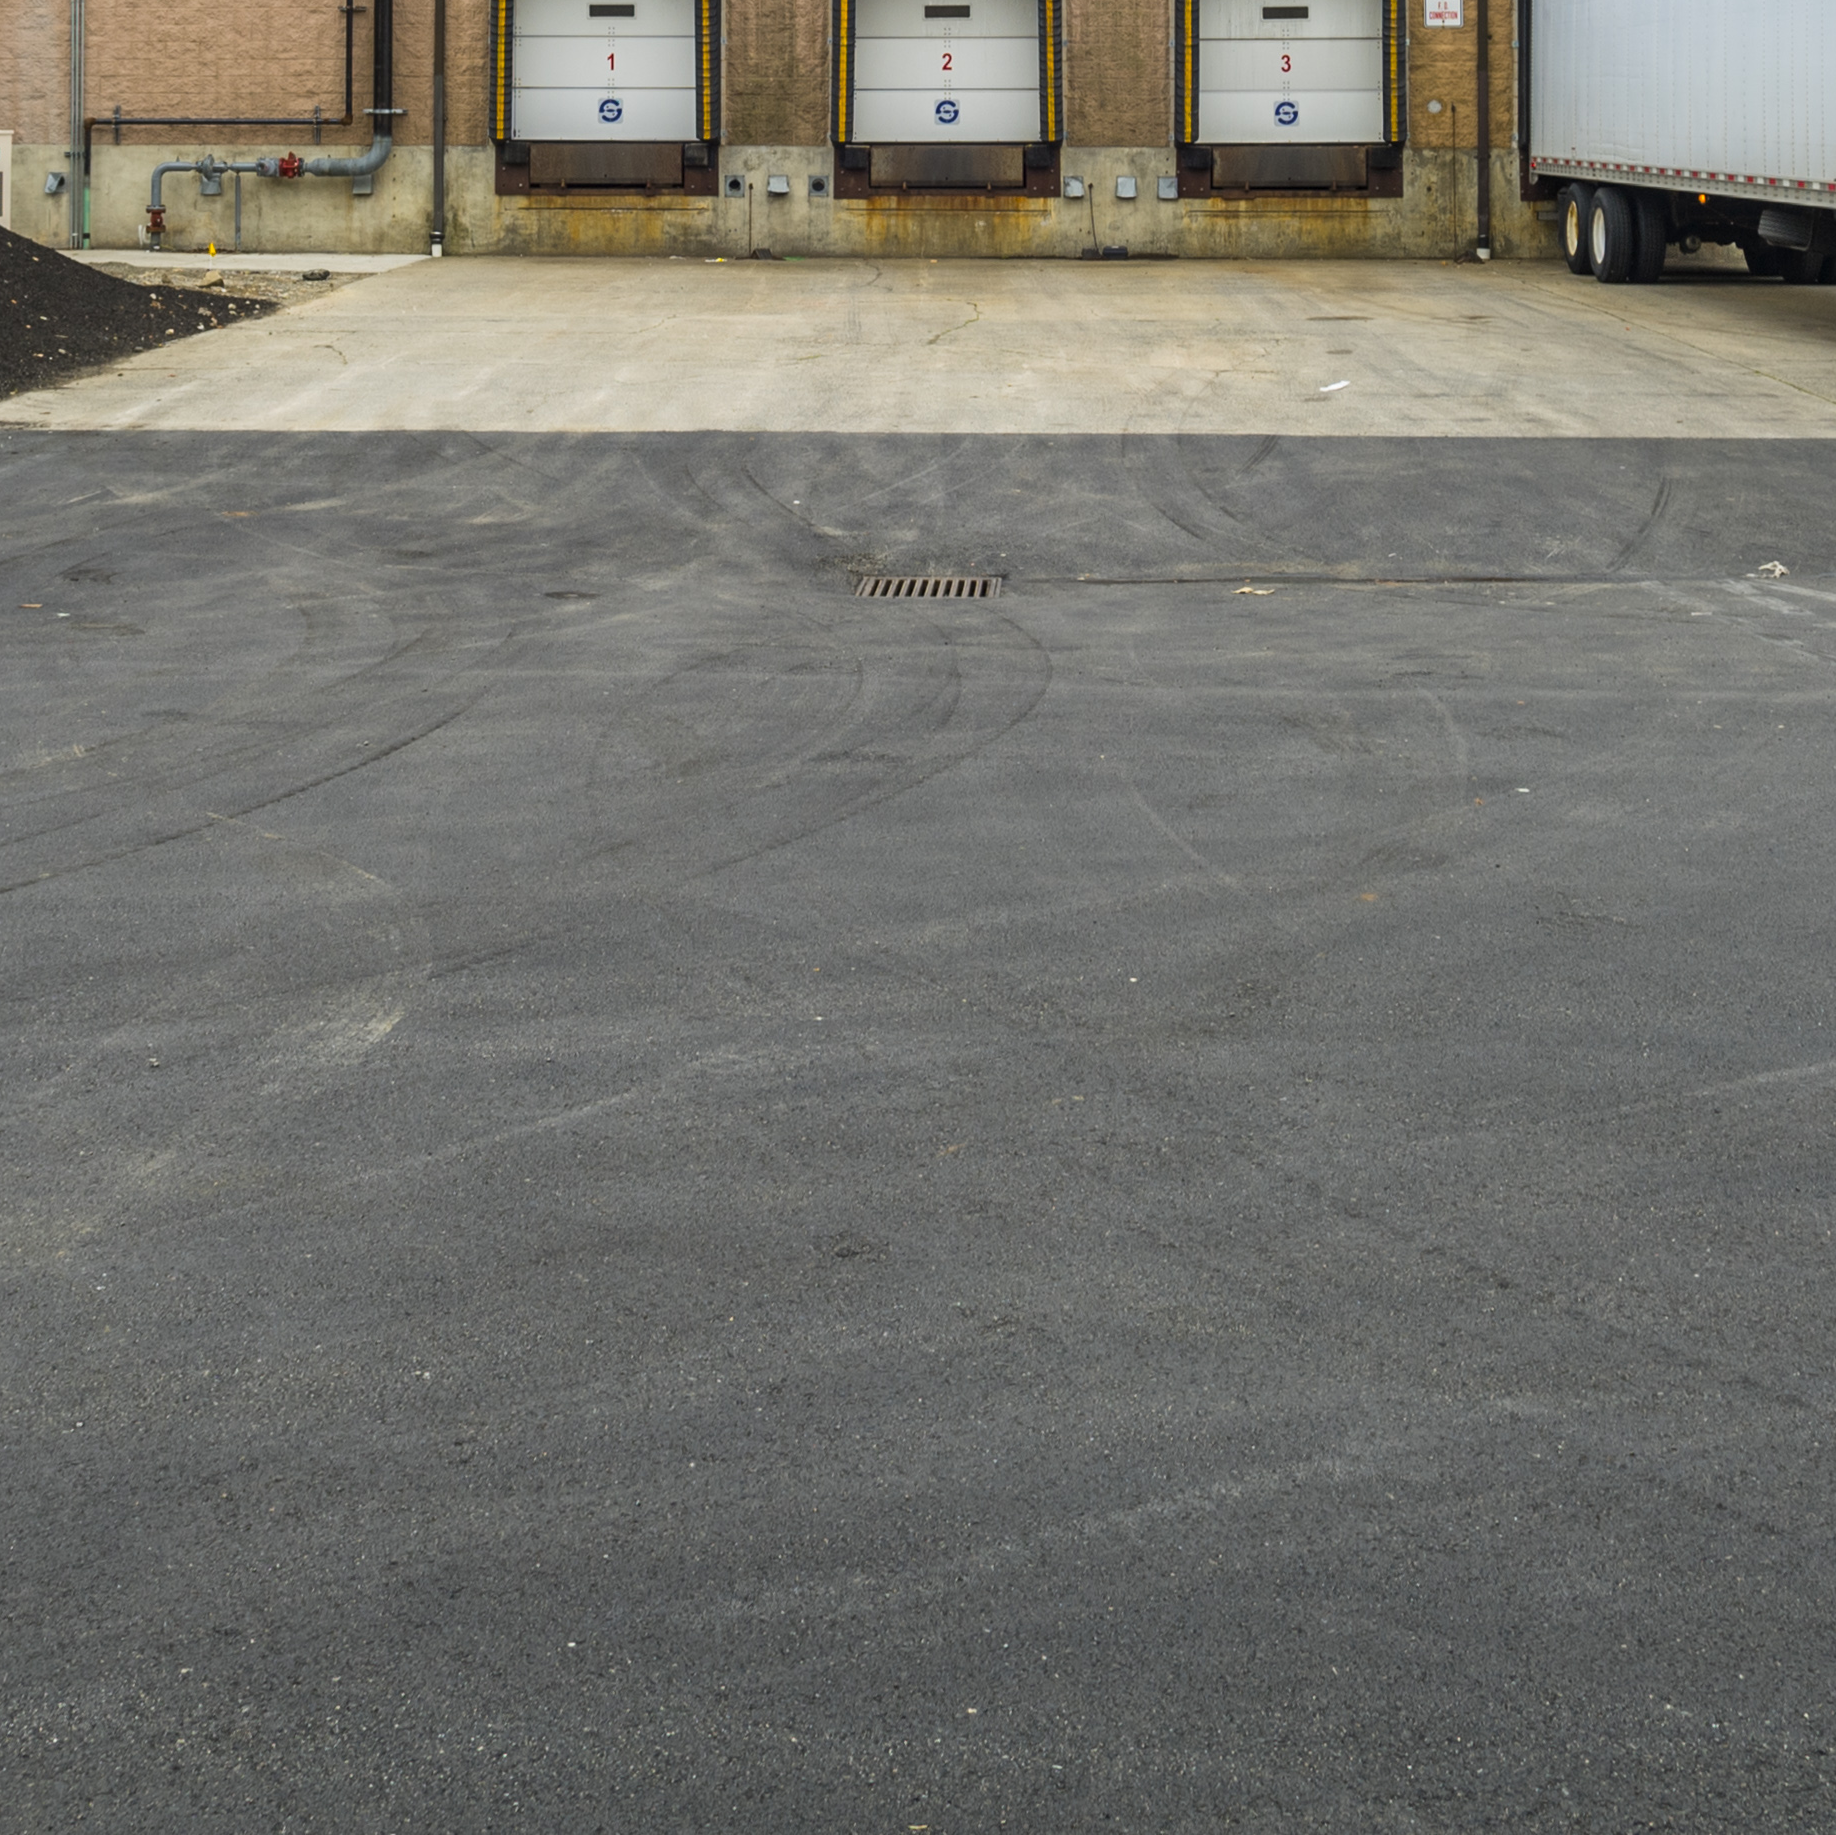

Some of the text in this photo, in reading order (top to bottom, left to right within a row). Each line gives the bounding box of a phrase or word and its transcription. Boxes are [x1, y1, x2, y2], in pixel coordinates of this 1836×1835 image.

[1428, 11, 1458, 20] CONNECTION
[607, 53, 615, 71] 1
[942, 53, 953, 71] 2
[1281, 54, 1292, 73] 3
